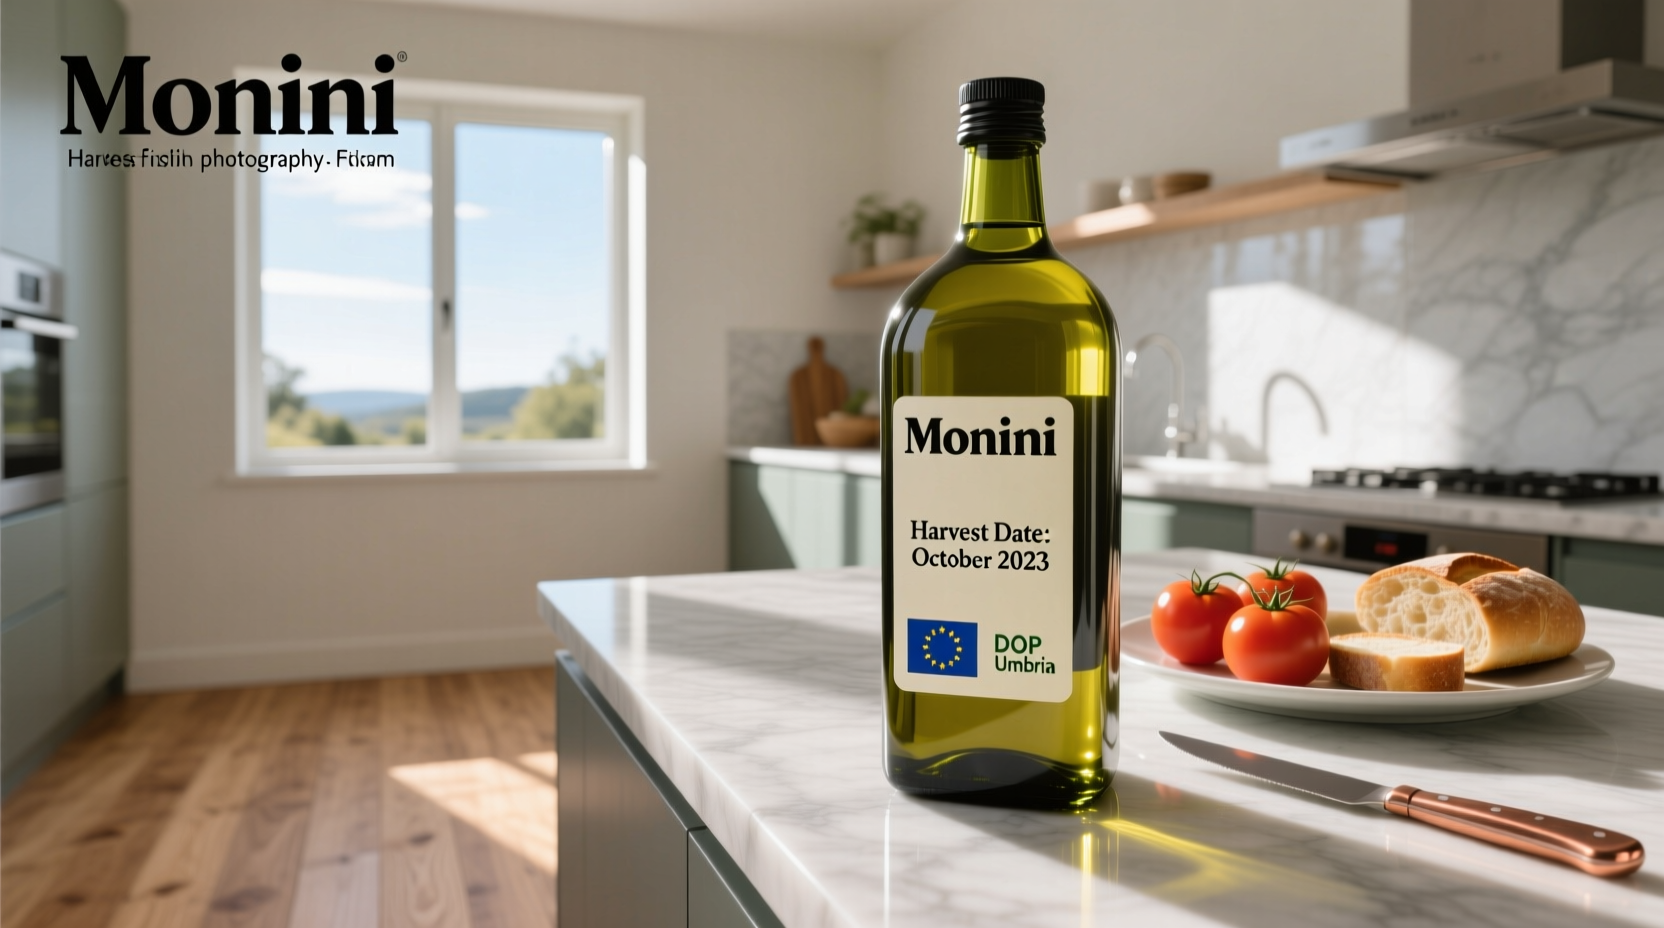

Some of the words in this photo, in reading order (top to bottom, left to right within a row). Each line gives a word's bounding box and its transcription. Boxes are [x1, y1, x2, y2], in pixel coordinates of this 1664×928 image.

[904, 416, 1057, 456] Monini
[910, 520, 989, 542] Harvest
[994, 522, 1051, 543] Date:
[911, 547, 992, 569] October
[997, 551, 1050, 571] 2023
[994, 634, 1042, 654] DOP
[995, 656, 1056, 674] Umbria
